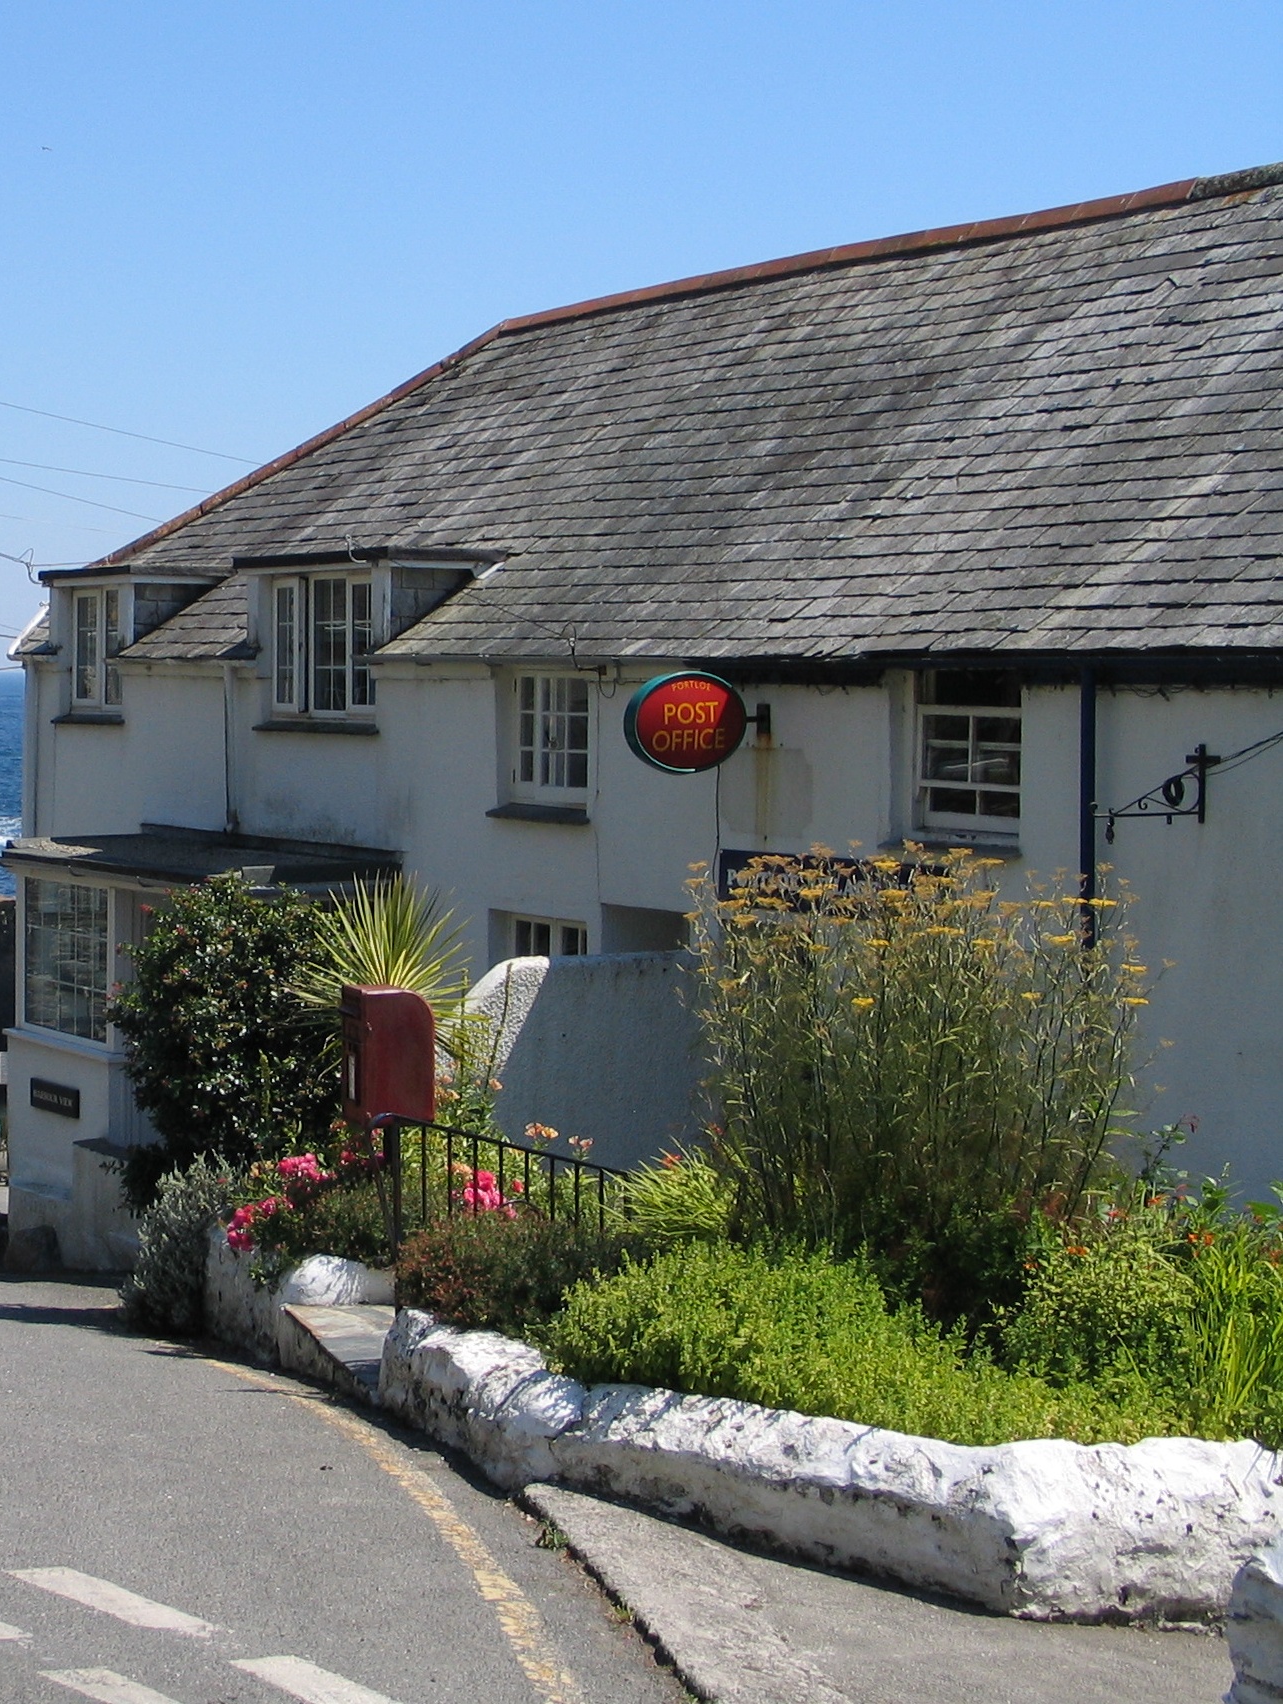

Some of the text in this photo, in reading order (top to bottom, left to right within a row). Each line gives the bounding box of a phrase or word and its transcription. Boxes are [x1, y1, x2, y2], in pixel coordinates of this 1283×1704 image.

[671, 680, 711, 692] PORTLOE
[663, 701, 719, 725] POST
[652, 728, 725, 752] OFFICE
